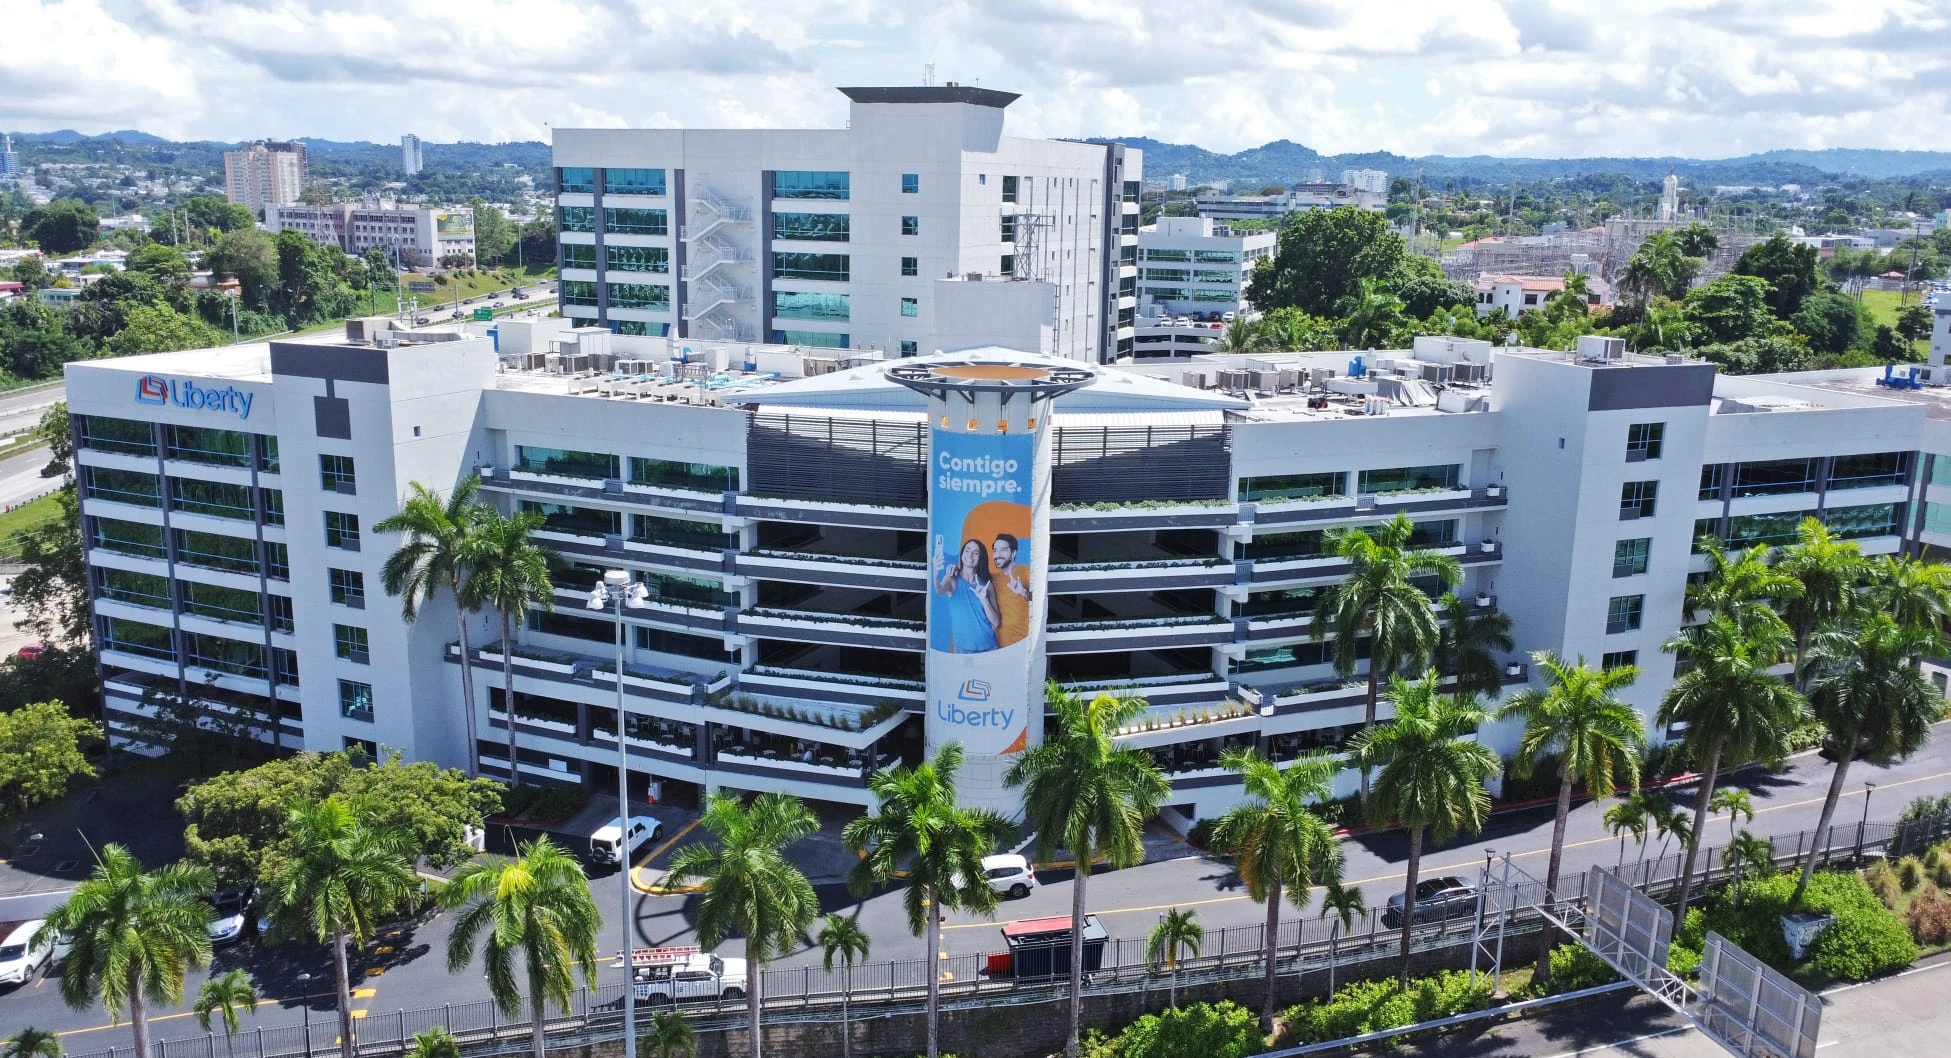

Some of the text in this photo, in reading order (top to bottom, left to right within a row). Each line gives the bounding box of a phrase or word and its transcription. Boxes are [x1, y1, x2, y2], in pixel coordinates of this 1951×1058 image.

[170, 379, 253, 419] Liberty
[939, 451, 1018, 477] Contigo
[939, 472, 1022, 497] siempre.
[938, 699, 1014, 729] Liberty
